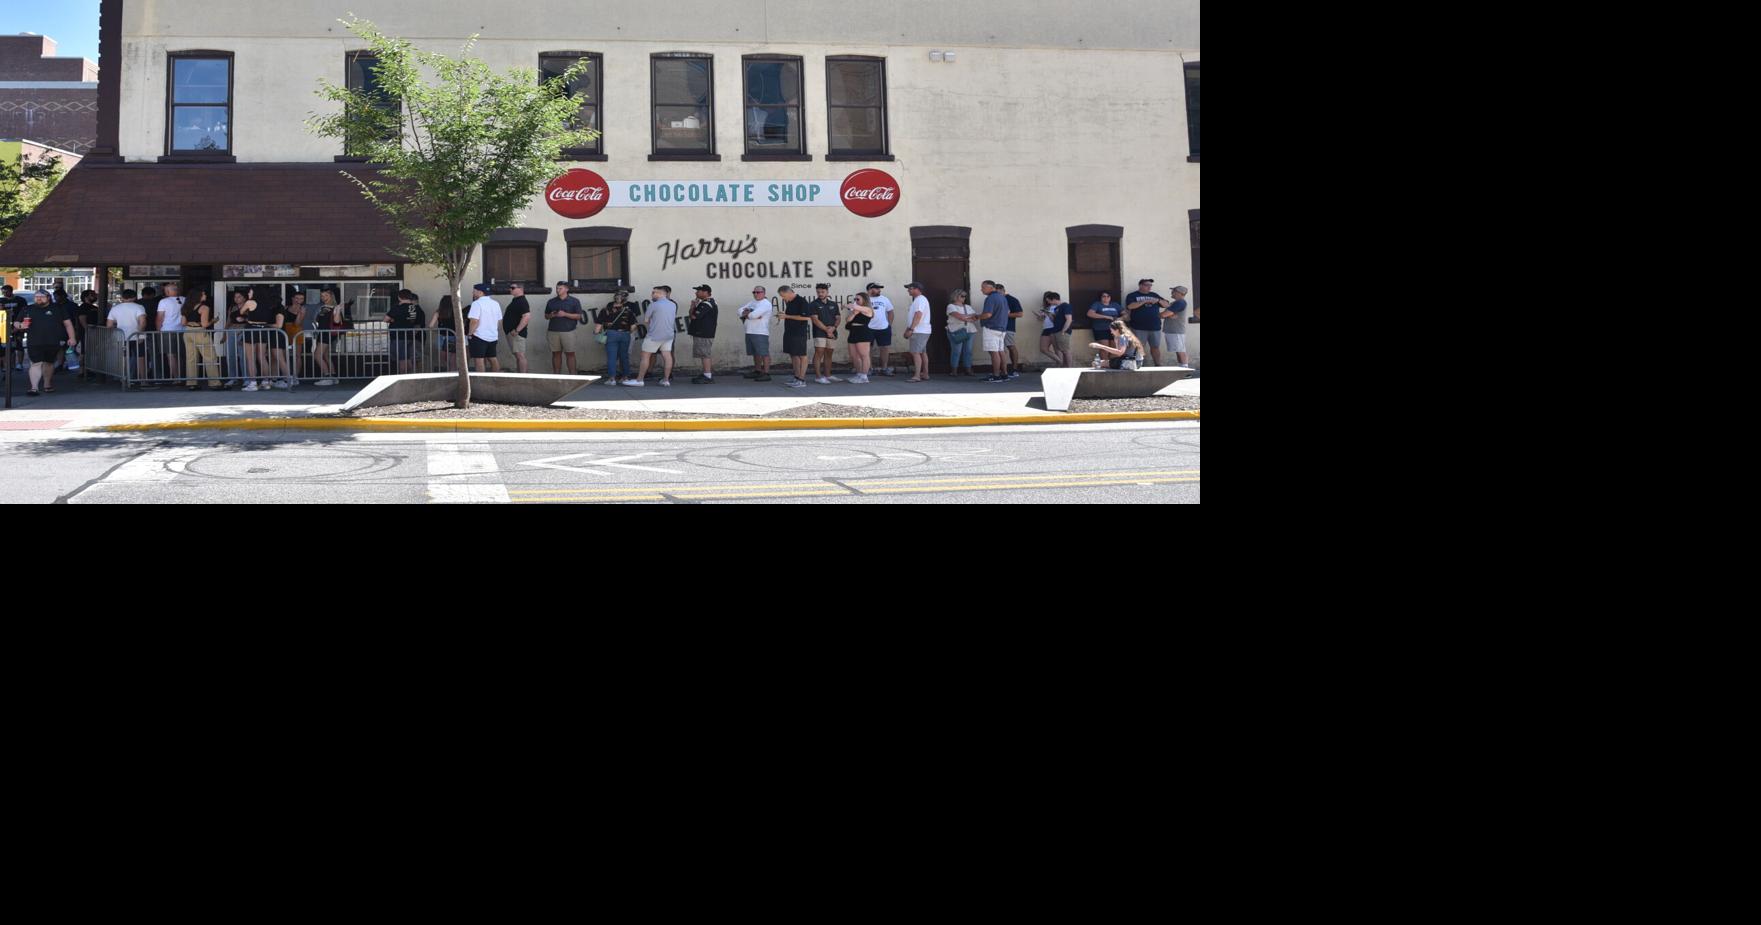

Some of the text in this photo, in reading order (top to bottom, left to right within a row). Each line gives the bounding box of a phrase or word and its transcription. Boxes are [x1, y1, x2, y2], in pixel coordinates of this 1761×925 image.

[549, 186, 604, 201] Coca-Cola
[629, 183, 821, 202] CHOCOLATE SHOP
[844, 186, 895, 200] Coca-Cola
[657, 234, 758, 271] Harry's
[706, 260, 873, 279] CHOCOLATE SHOP
